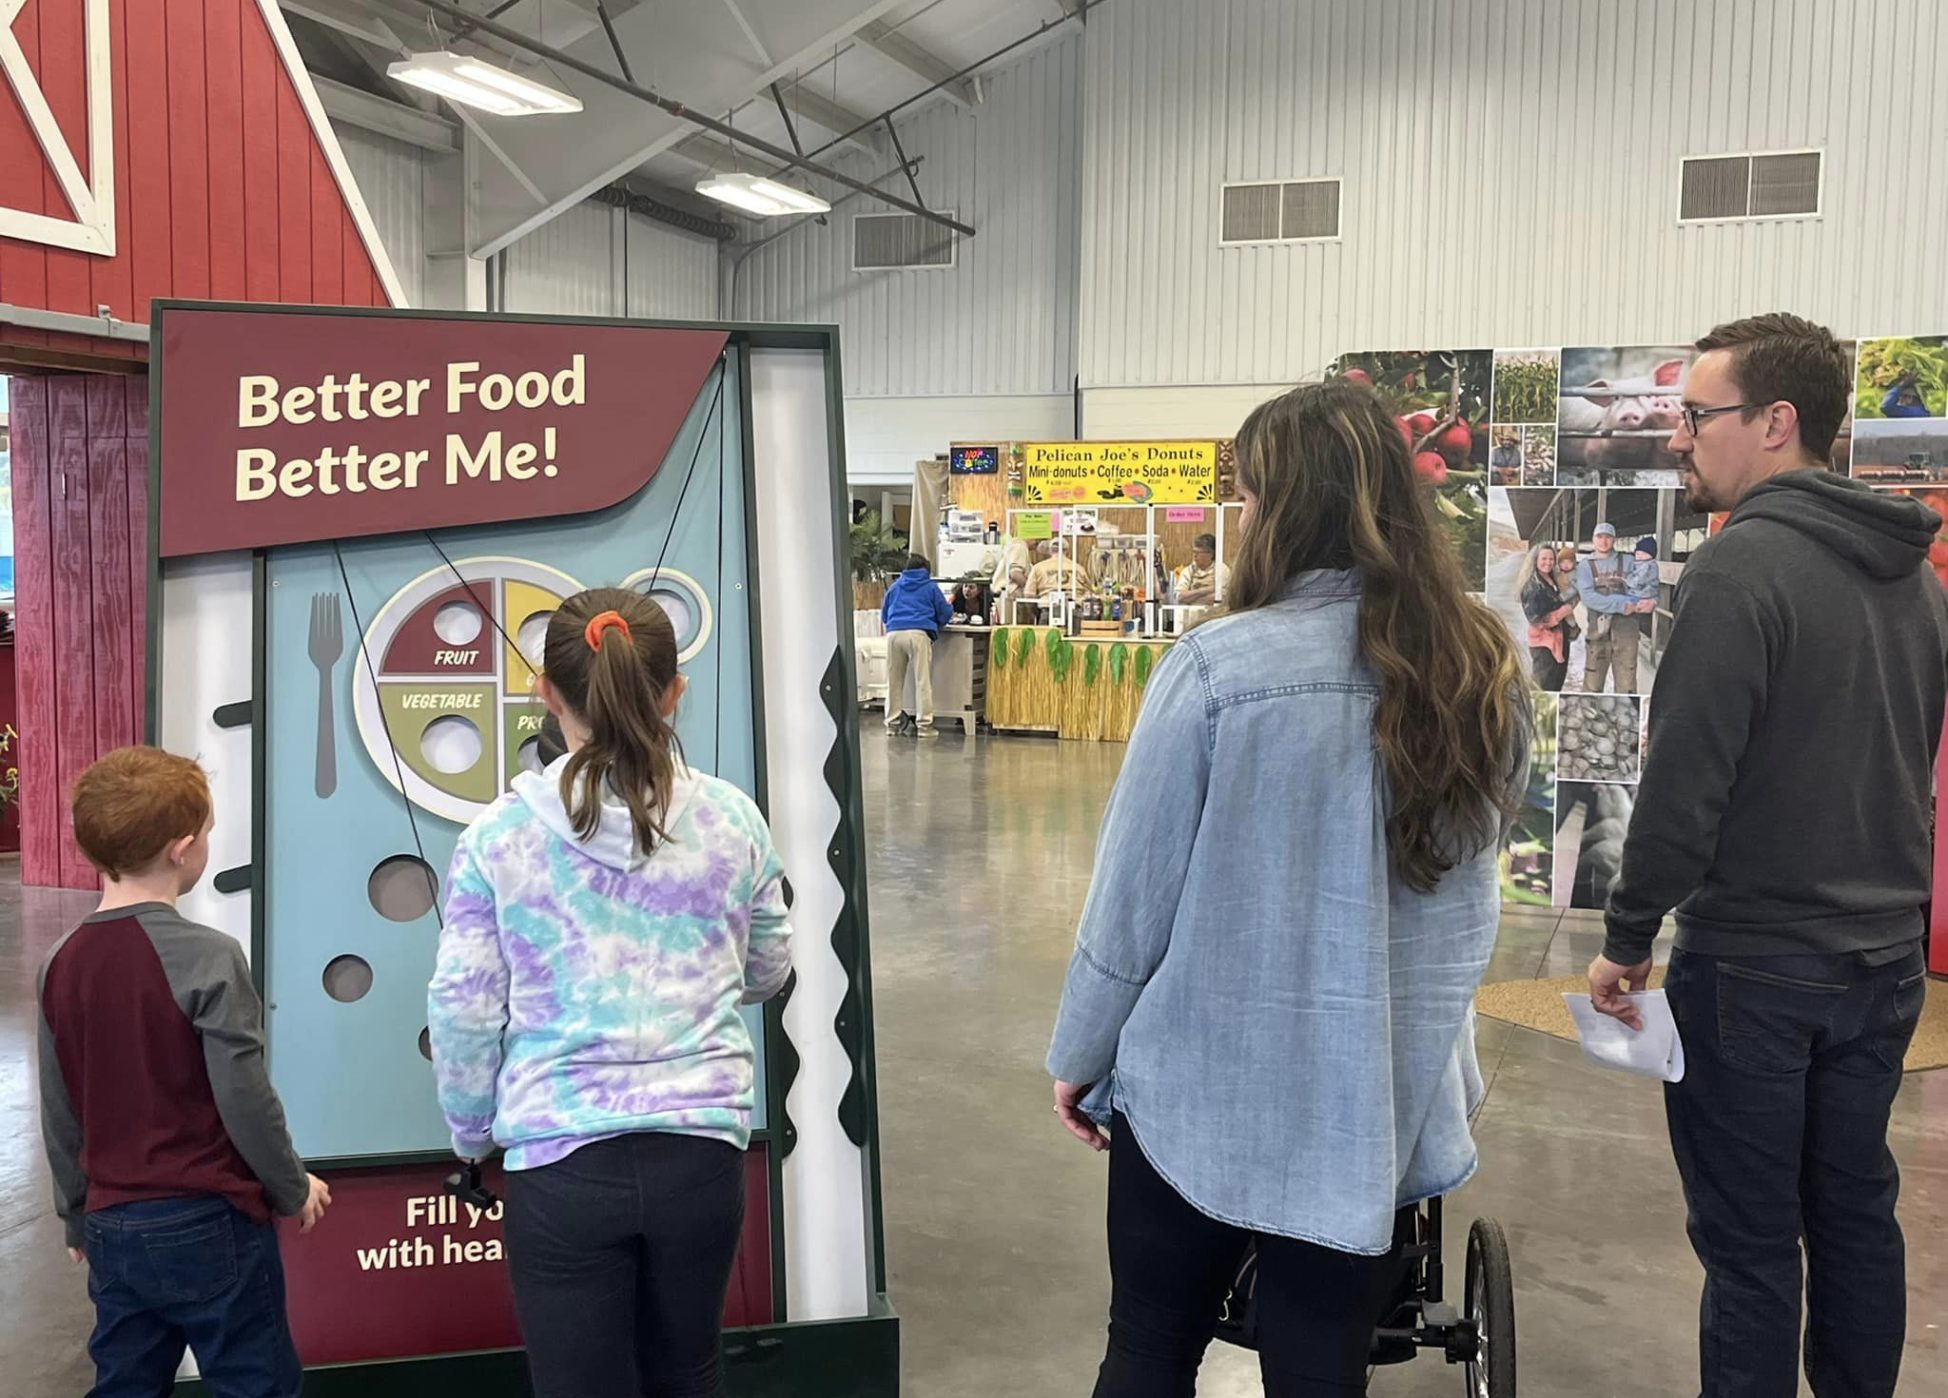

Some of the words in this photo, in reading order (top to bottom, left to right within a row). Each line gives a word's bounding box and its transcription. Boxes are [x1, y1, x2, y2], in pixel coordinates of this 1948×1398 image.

[238, 372, 431, 428] Better
[447, 353, 586, 414] Food
[235, 445, 429, 502] Better
[445, 426, 559, 486] Me!
[1036, 448, 1093, 462] Pelican
[1100, 447, 1139, 462] Joe's
[1147, 447, 1203, 461] Donuts
[1029, 465, 1088, 478] Mini-donuts
[1097, 464, 1133, 478] Coffee
[1142, 464, 1169, 478] Soda
[1178, 464, 1212, 478] Water
[434, 650, 480, 666] FRUIT
[402, 693, 483, 710] VEGETABLE
[406, 1195, 457, 1227] Fill
[464, 1199, 504, 1229] yo
[356, 1236, 435, 1271] with
[443, 1234, 507, 1265] hea
